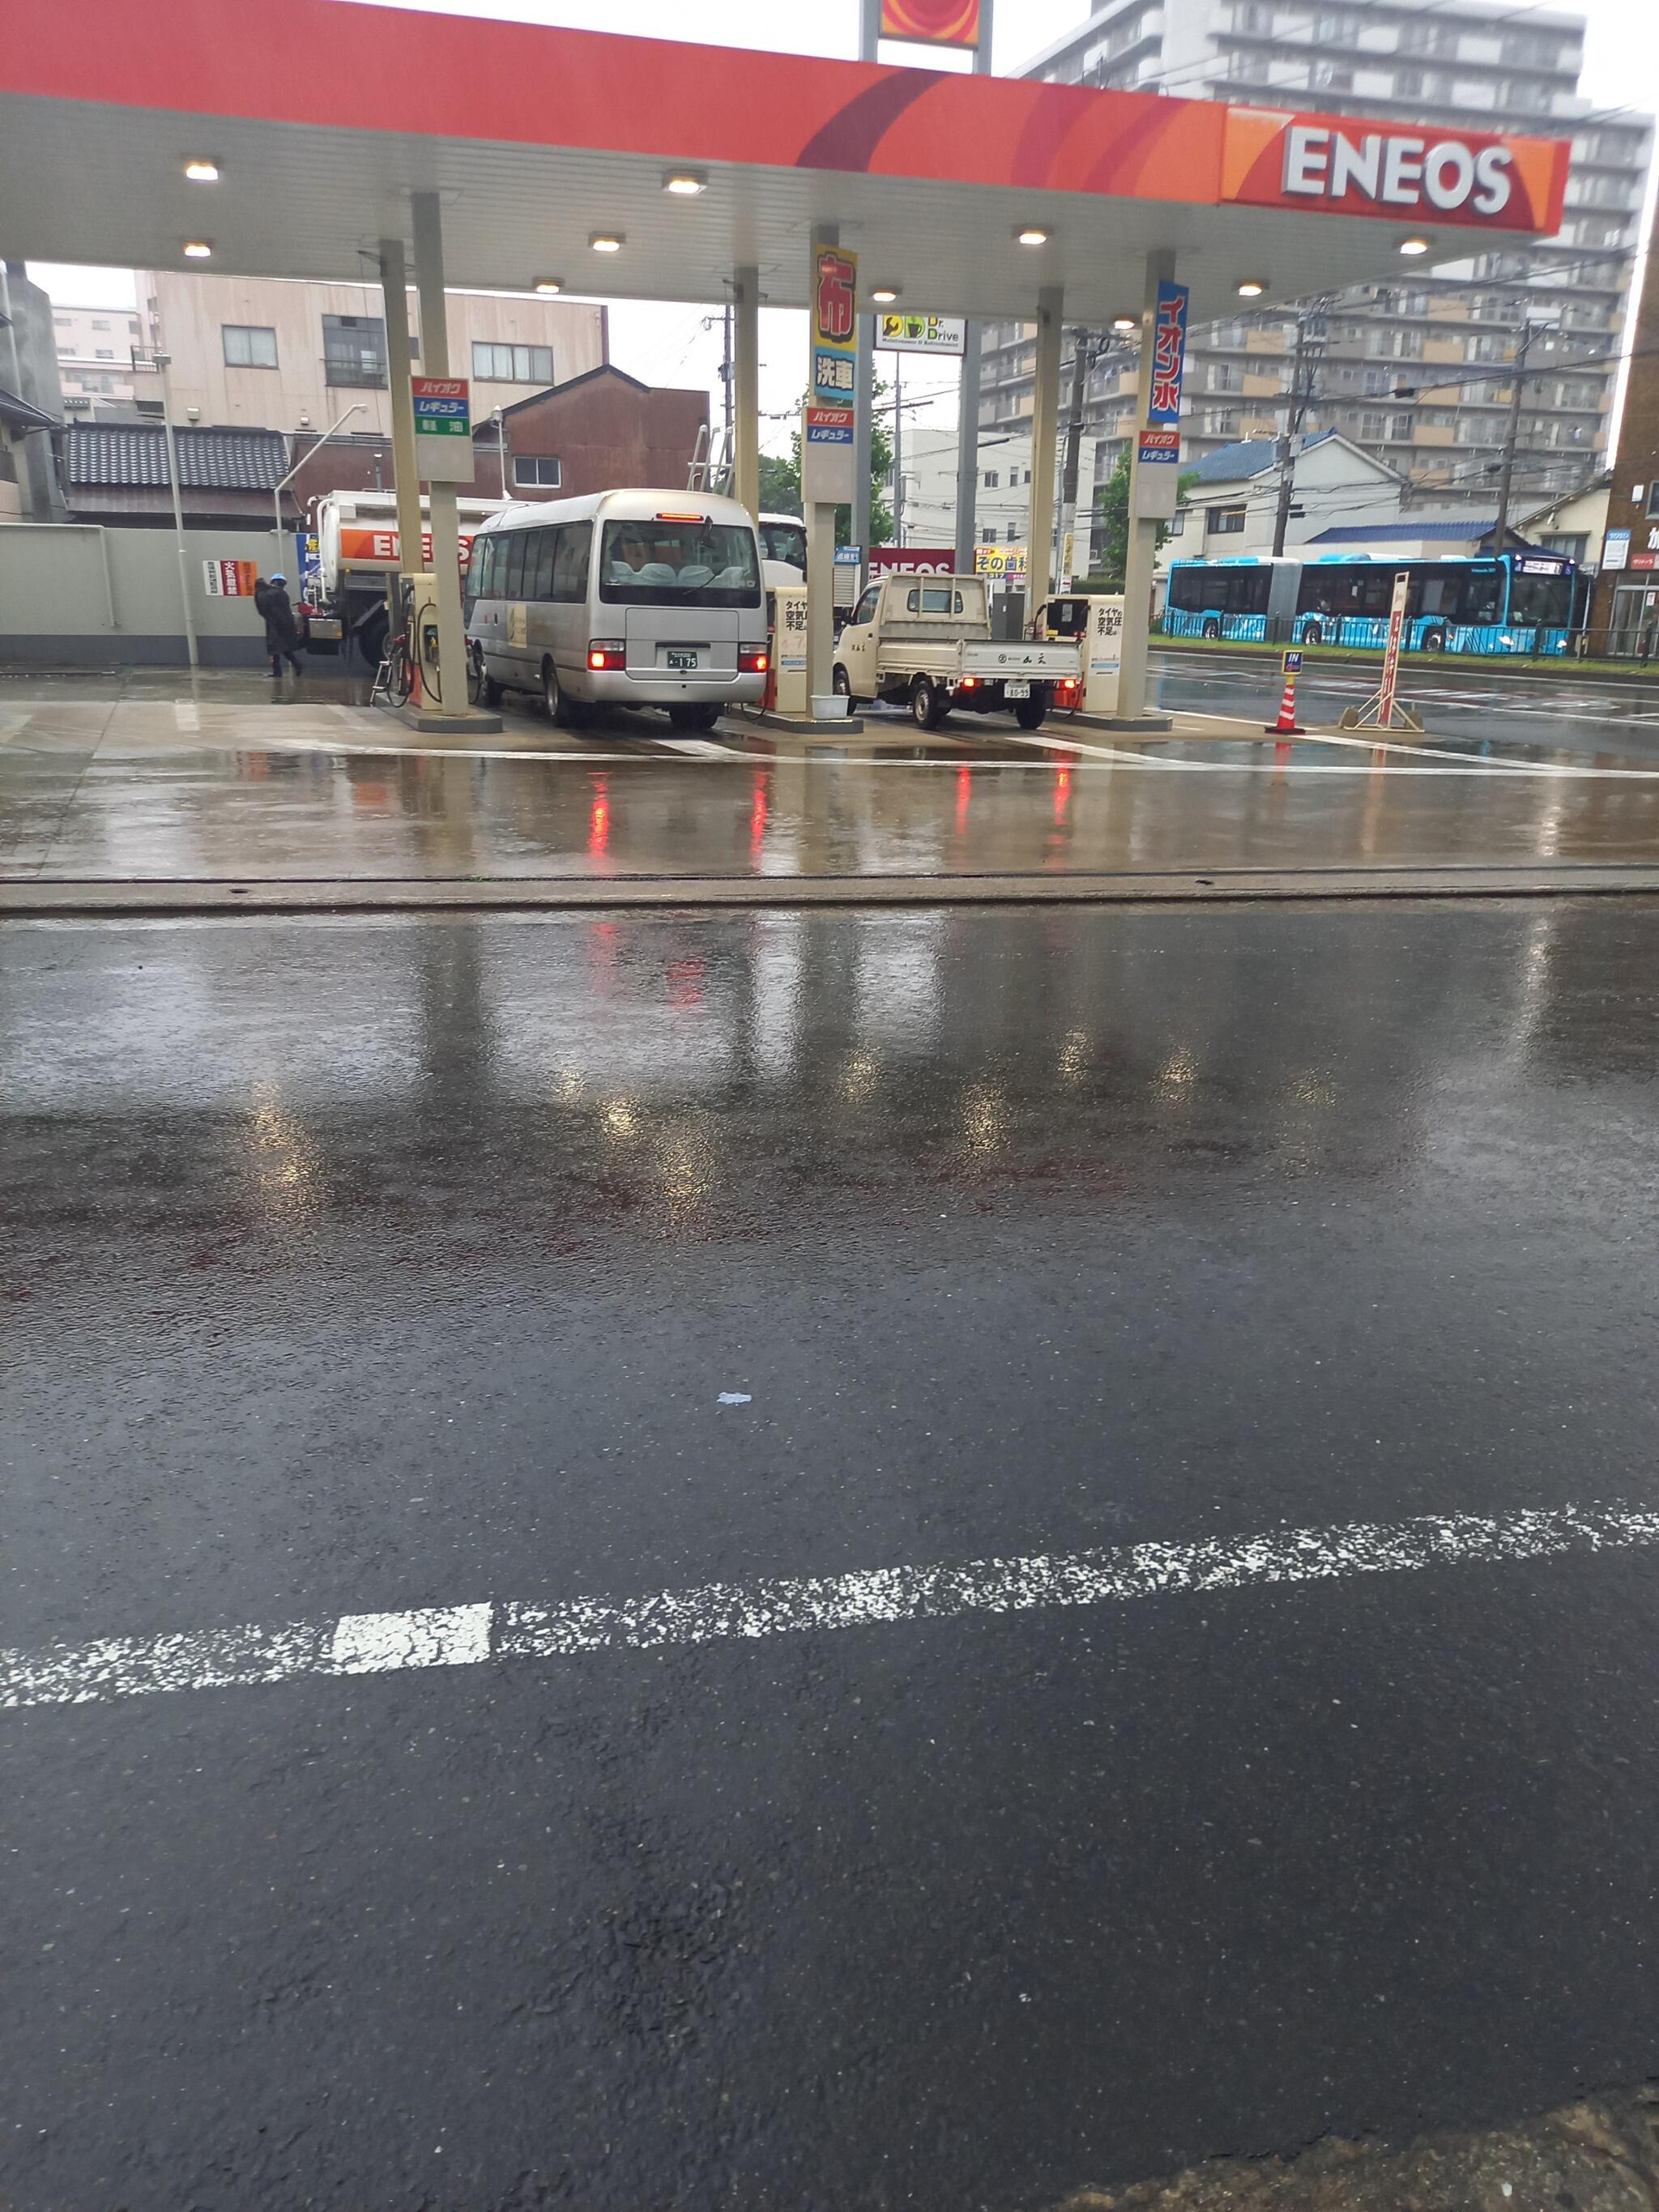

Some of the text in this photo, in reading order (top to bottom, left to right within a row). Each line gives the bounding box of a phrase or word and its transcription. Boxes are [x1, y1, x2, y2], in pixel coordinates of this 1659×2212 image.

[1282, 126, 1513, 215] ENEOS
[818, 253, 855, 342] 布
[928, 315, 944, 327] Dr.
[928, 328, 958, 341] Drive
[1152, 296, 1184, 411] イオン水
[817, 356, 854, 390] 洗車
[420, 381, 461, 394] ハイオク
[419, 401, 464, 413] レギュラー
[813, 411, 848, 423] ハイオク
[422, 420, 463, 432] 軽油
[811, 428, 850, 441] レギュラー
[1145, 433, 1175, 445] ハイオク
[1142, 450, 1175, 461] レギュラー
[1098, 607, 1122, 616] タイヤの
[1098, 617, 1122, 626] 空気圧
[1288, 653, 1299, 663] IN
